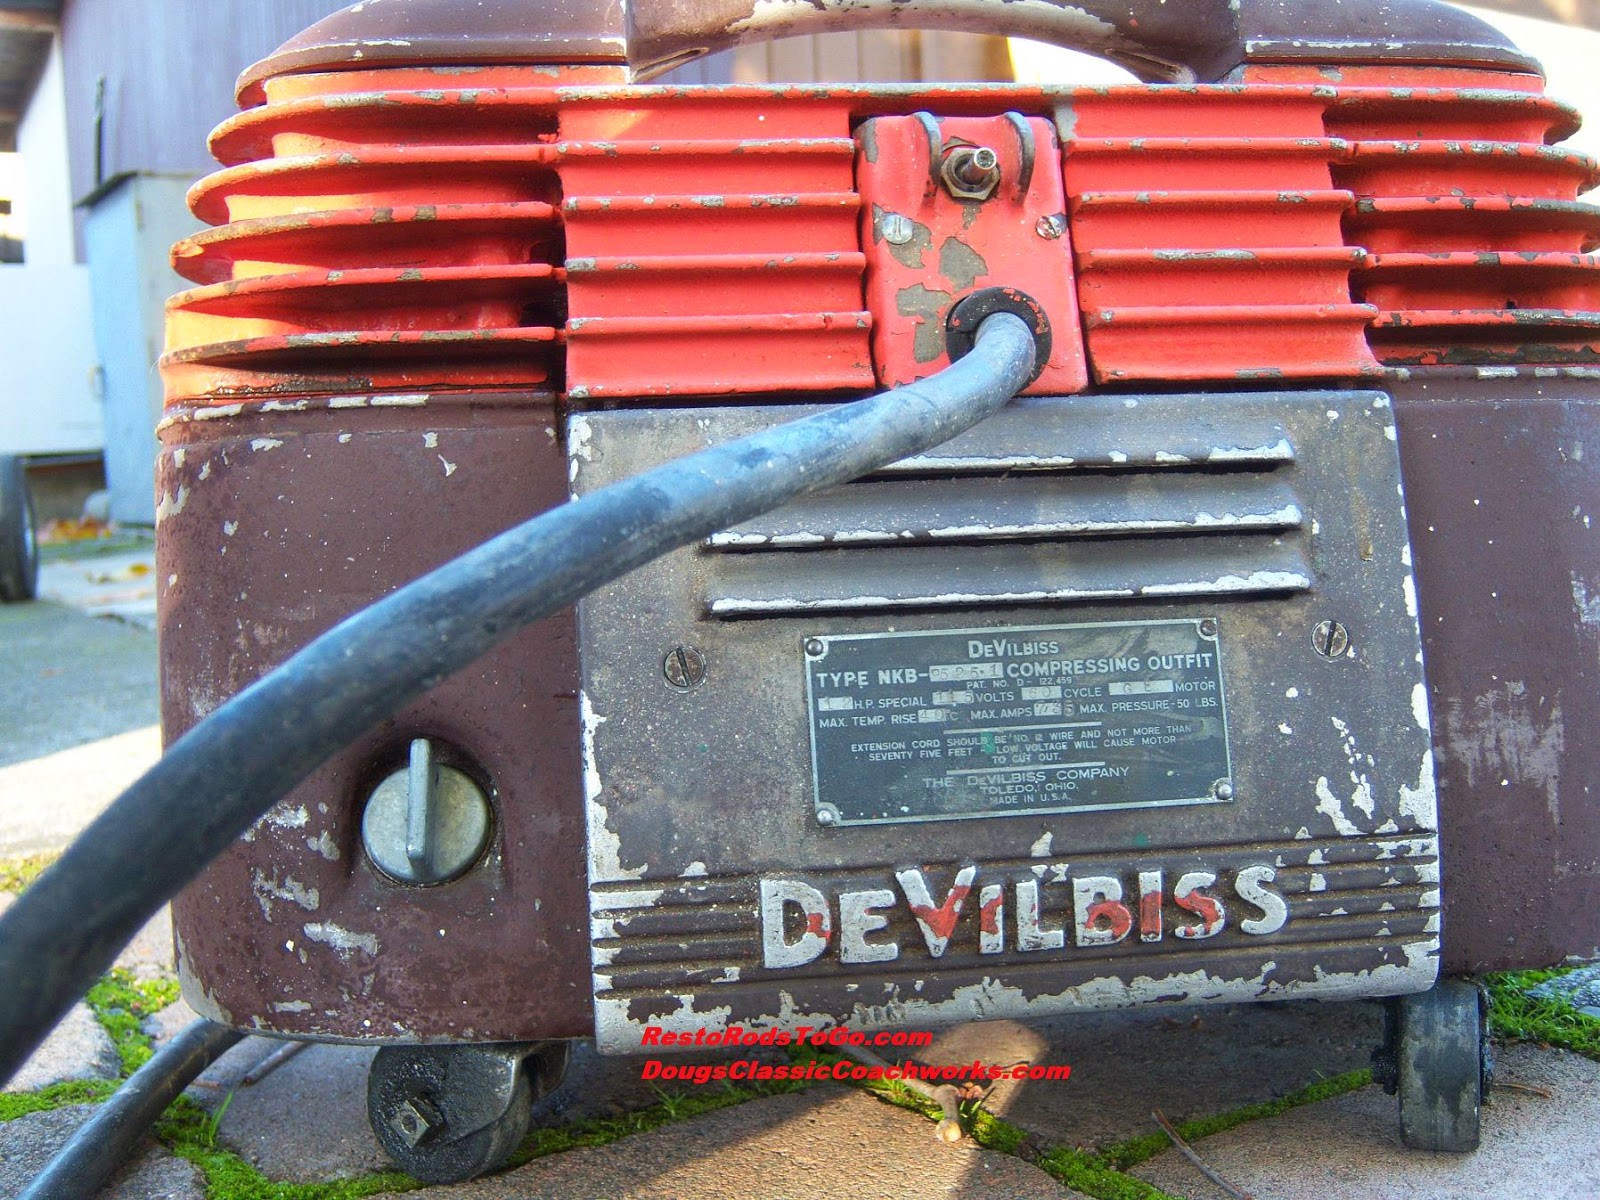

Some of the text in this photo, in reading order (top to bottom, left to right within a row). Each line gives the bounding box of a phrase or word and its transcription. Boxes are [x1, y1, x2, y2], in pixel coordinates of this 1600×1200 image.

[816, 671, 868, 687] TYPE
[1007, 657, 1140, 677] COMPRESSING
[1148, 653, 1212, 670] OUTFIT
[855, 700, 874, 709] H.P.
[879, 697, 927, 708] SPECIAL
[976, 691, 1014, 702] VOLTS
[1064, 687, 1102, 698] CYCLE
[1175, 682, 1215, 692] MOTOR
[967, 681, 986, 689] PAT.
[820, 717, 847, 728] MAX.
[852, 716, 886, 726] TEMP.
[892, 714, 916, 724] RISE
[971, 710, 998, 720] MAX.
[1000, 706, 1032, 717] AMPS
[1080, 704, 1106, 713] MAX.
[1195, 698, 1218, 707] LBS.
[851, 742, 905, 752] EXTENSION
[912, 739, 940, 748] CORD
[947, 736, 987, 746] SHOULD
[994, 735, 1007, 743] BE
[1050, 731, 1073, 740] WIRE
[1080, 730, 1101, 739] AND
[1107, 728, 1127, 737] NOT
[1133, 727, 1160, 735] MORE
[1167, 725, 1191, 734] THAN
[869, 750, 912, 761] SEVENTY
[920, 749, 941, 758] FIVE
[948, 748, 972, 756] FEET
[1025, 741, 1067, 752] VOLTAGE
[1074, 740, 1097, 748] WILL
[1103, 739, 1135, 747] CAUSE
[1142, 736, 1177, 744] MOTOR
[992, 753, 1061, 764] TO CUT OUT.
[922, 777, 954, 787] THE
[1056, 767, 1129, 780] COMPANY
[1045, 782, 1079, 791] OHIO.
[990, 796, 1018, 804] MADE
[1024, 795, 1034, 803] IN
